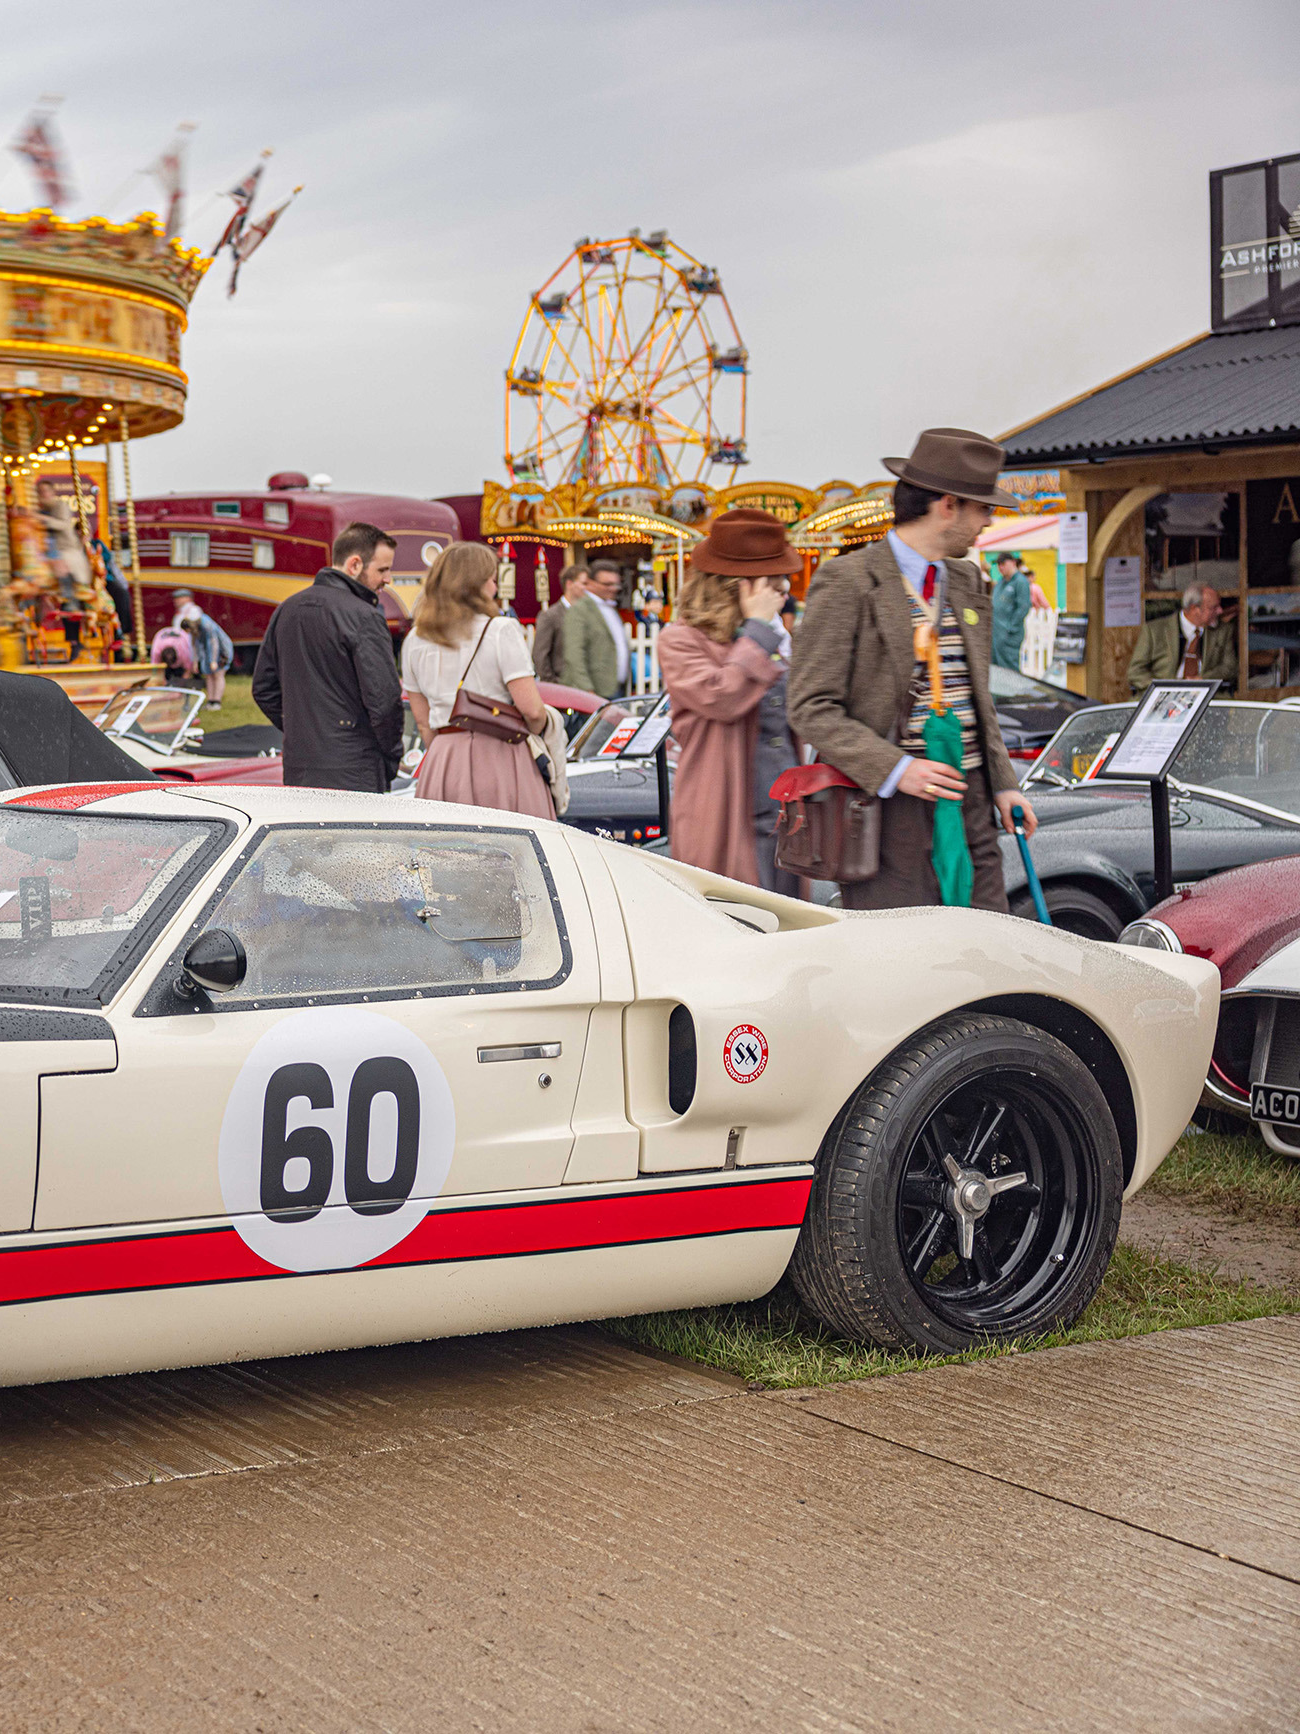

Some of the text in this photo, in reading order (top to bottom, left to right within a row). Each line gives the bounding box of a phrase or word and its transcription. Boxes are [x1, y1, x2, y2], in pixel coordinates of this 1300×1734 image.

[1254, 259, 1299, 274] PREMIER
[726, 1026, 768, 1050] ESSEX WIRE
[724, 1053, 768, 1083] CORPORATION
[260, 1056, 420, 1223] 60
